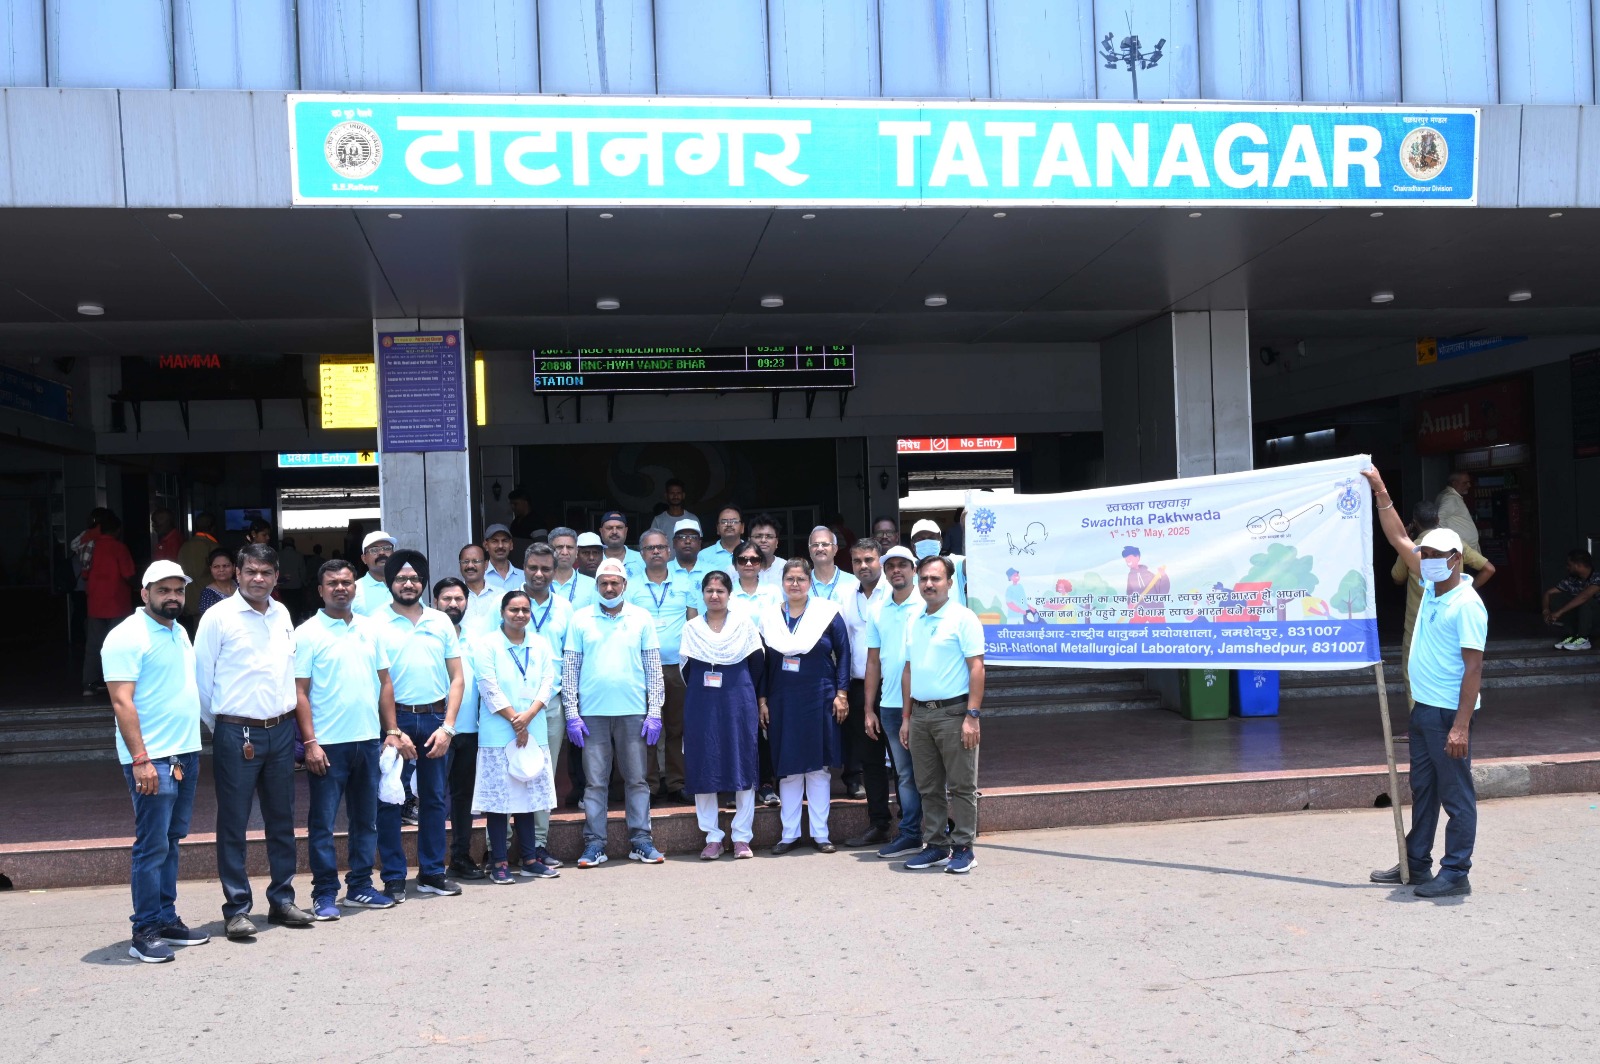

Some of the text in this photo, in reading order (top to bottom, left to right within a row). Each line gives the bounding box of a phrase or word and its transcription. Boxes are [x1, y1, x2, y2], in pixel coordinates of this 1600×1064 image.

[396, 115, 812, 187] टाटानगर
[878, 119, 1384, 190] TATANAGAR
[1393, 184, 1453, 193] Chakradharpur Division
[160, 353, 221, 369] MAMMA
[540, 357, 847, 371] 20898 RNC-HWH VANDE BHAR 09:23 A 04
[534, 375, 584, 387] STATION
[1418, 402, 1471, 435] Amul
[897, 439, 921, 450] निषेध
[960, 438, 1003, 449] No Entry
[321, 453, 351, 463] Entry
[1106, 498, 1193, 513] स्वच्छता पखवाड़ा
[1080, 509, 1221, 529] Swachhta Pakhwada
[1143, 527, 1165, 538] May,
[1167, 526, 1190, 536] 2025
[1231, 591, 1257, 600] भारत
[1261, 588, 1272, 600] हो
[1276, 589, 1306, 599] अपना
[1039, 610, 1055, 618] जन
[1058, 610, 1074, 618] जन
[1120, 609, 1135, 618] यह
[1197, 606, 1223, 616] भारत
[1227, 604, 1243, 615] बने
[1247, 606, 1275, 615] महान
[997, 625, 1341, 641] सीएसआईआर-राष्ट्रीय धातुकर्म प्रयोगशाला, जमशेदपुर, 831007
[984, 641, 1365, 656] CSIR-National Metallurgical Laboratory, Jamshedpur, 831007
